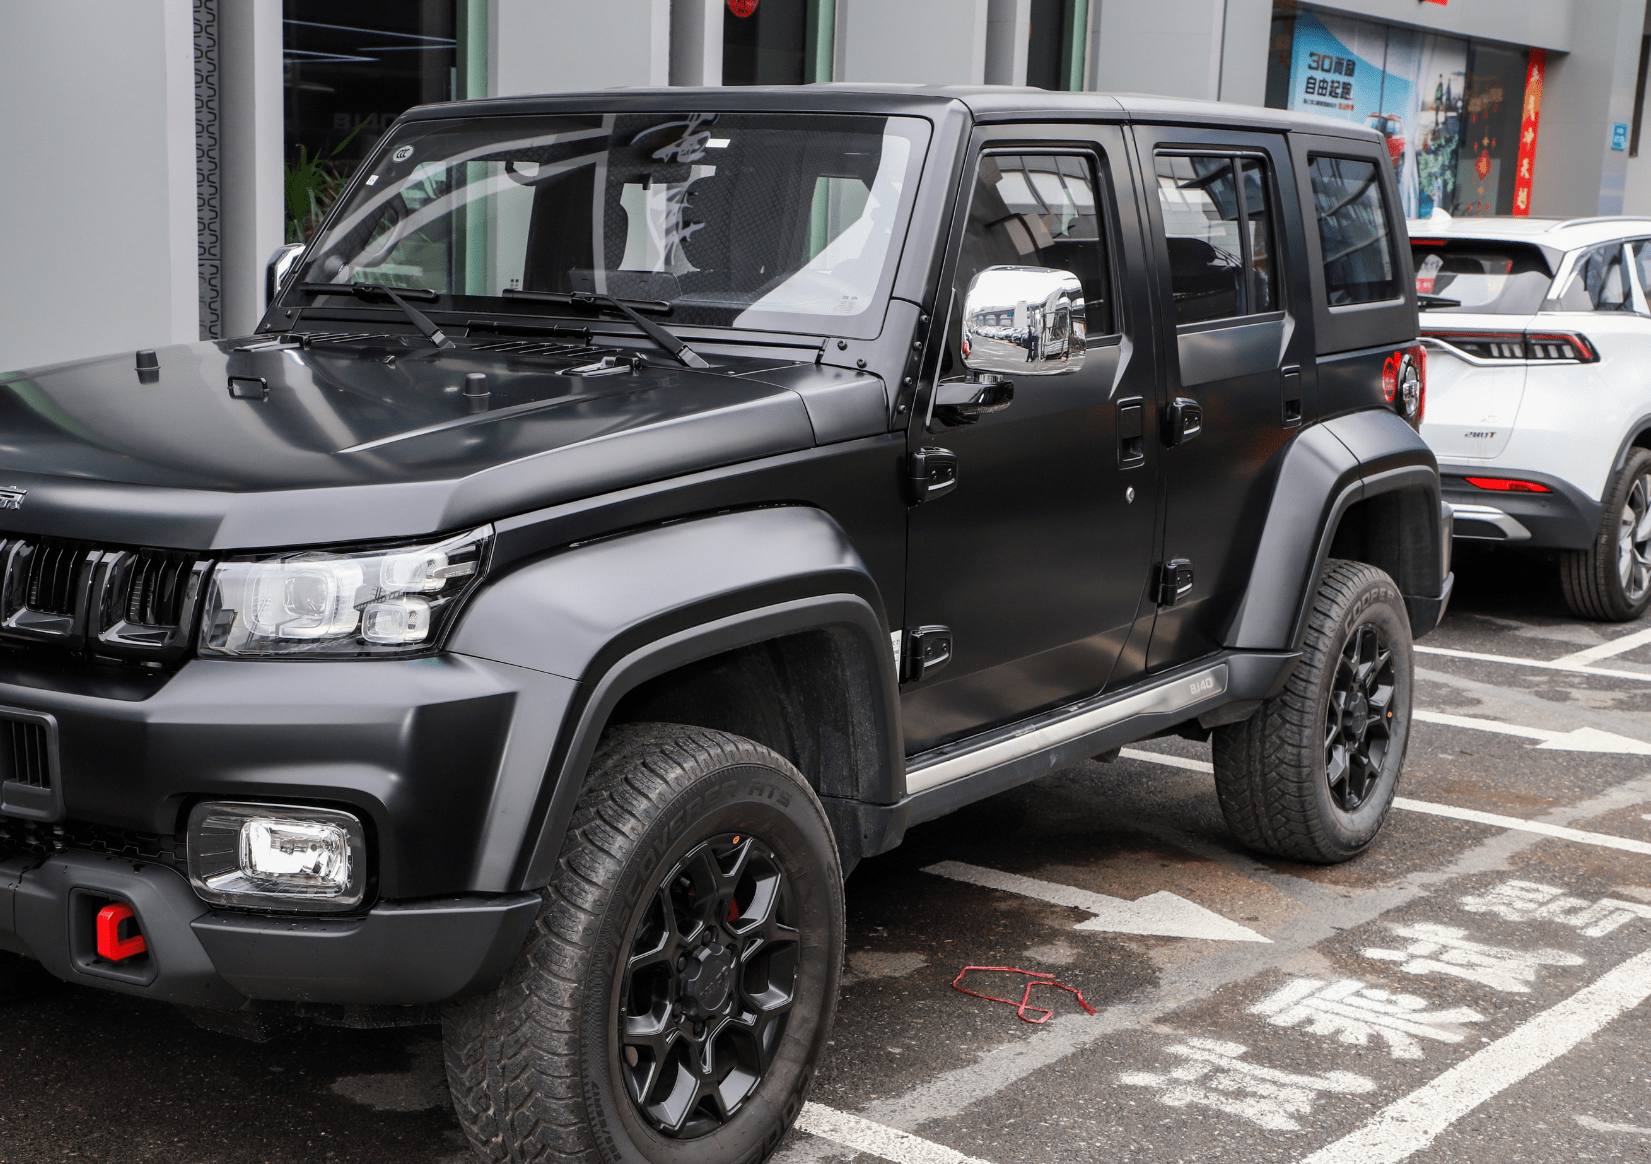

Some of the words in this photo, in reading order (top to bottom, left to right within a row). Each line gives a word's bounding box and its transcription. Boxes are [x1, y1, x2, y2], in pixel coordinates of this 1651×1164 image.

[1305, 75, 1353, 100] 自由起跑
[1345, 587, 1394, 632] COOPER
[1190, 678, 1213, 694] BJ40
[604, 779, 738, 974] DISCOVERER
[748, 779, 792, 807] ATS
[1119, 879, 1651, 1130] 试乘试驾
